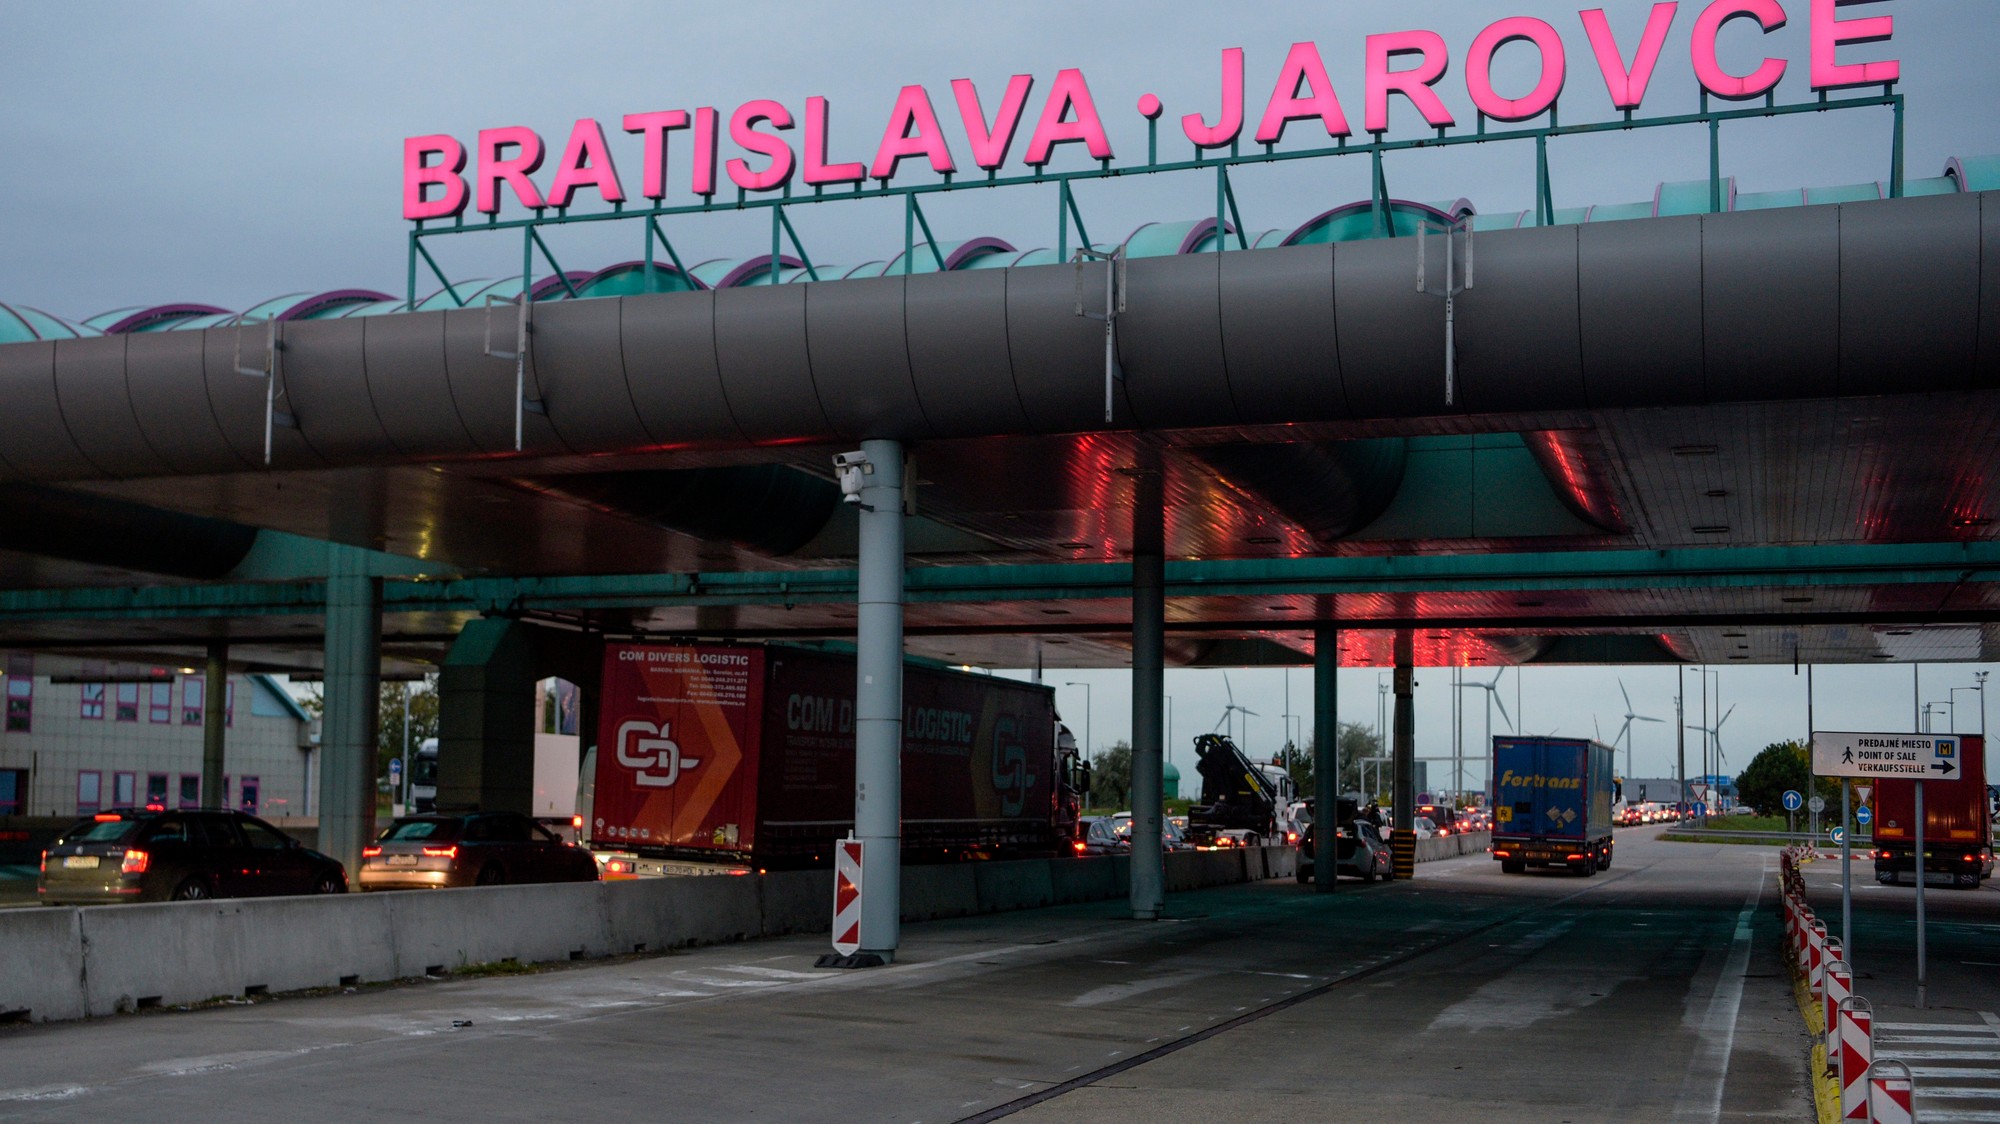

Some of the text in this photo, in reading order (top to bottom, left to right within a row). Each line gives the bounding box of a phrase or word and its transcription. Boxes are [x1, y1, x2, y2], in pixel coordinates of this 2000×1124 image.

[403, 0, 1900, 221] BRATISLAVA JAROVCE
[619, 651, 749, 666] COM DIVERS LOGISTIC
[787, 693, 835, 733] COM
[906, 704, 972, 743] LOGISTIC
[1858, 737, 1931, 749] PREDAJNÉ MIESTO
[1858, 751, 1917, 761] POINT OF SALE
[1858, 763, 1926, 773] VERKAUFSSTELLE
